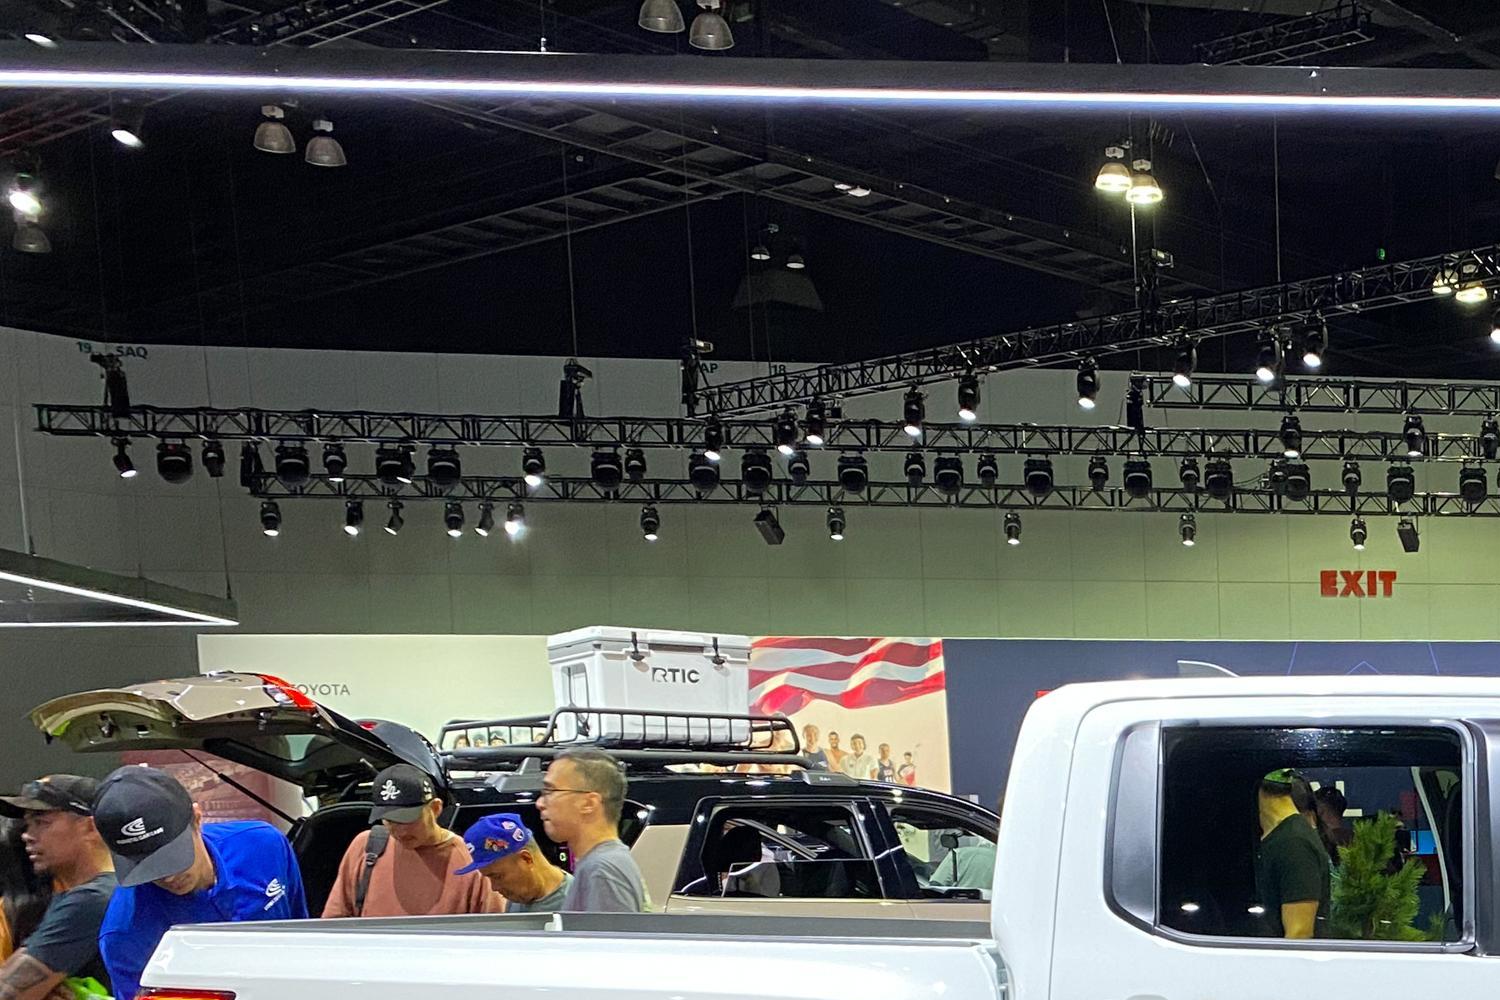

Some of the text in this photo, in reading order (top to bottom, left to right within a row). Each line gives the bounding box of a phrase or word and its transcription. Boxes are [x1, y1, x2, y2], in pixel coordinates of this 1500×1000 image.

[115, 346, 148, 359] SAQ
[1320, 570, 1397, 597] EXIT
[652, 667, 700, 684] RTIC
